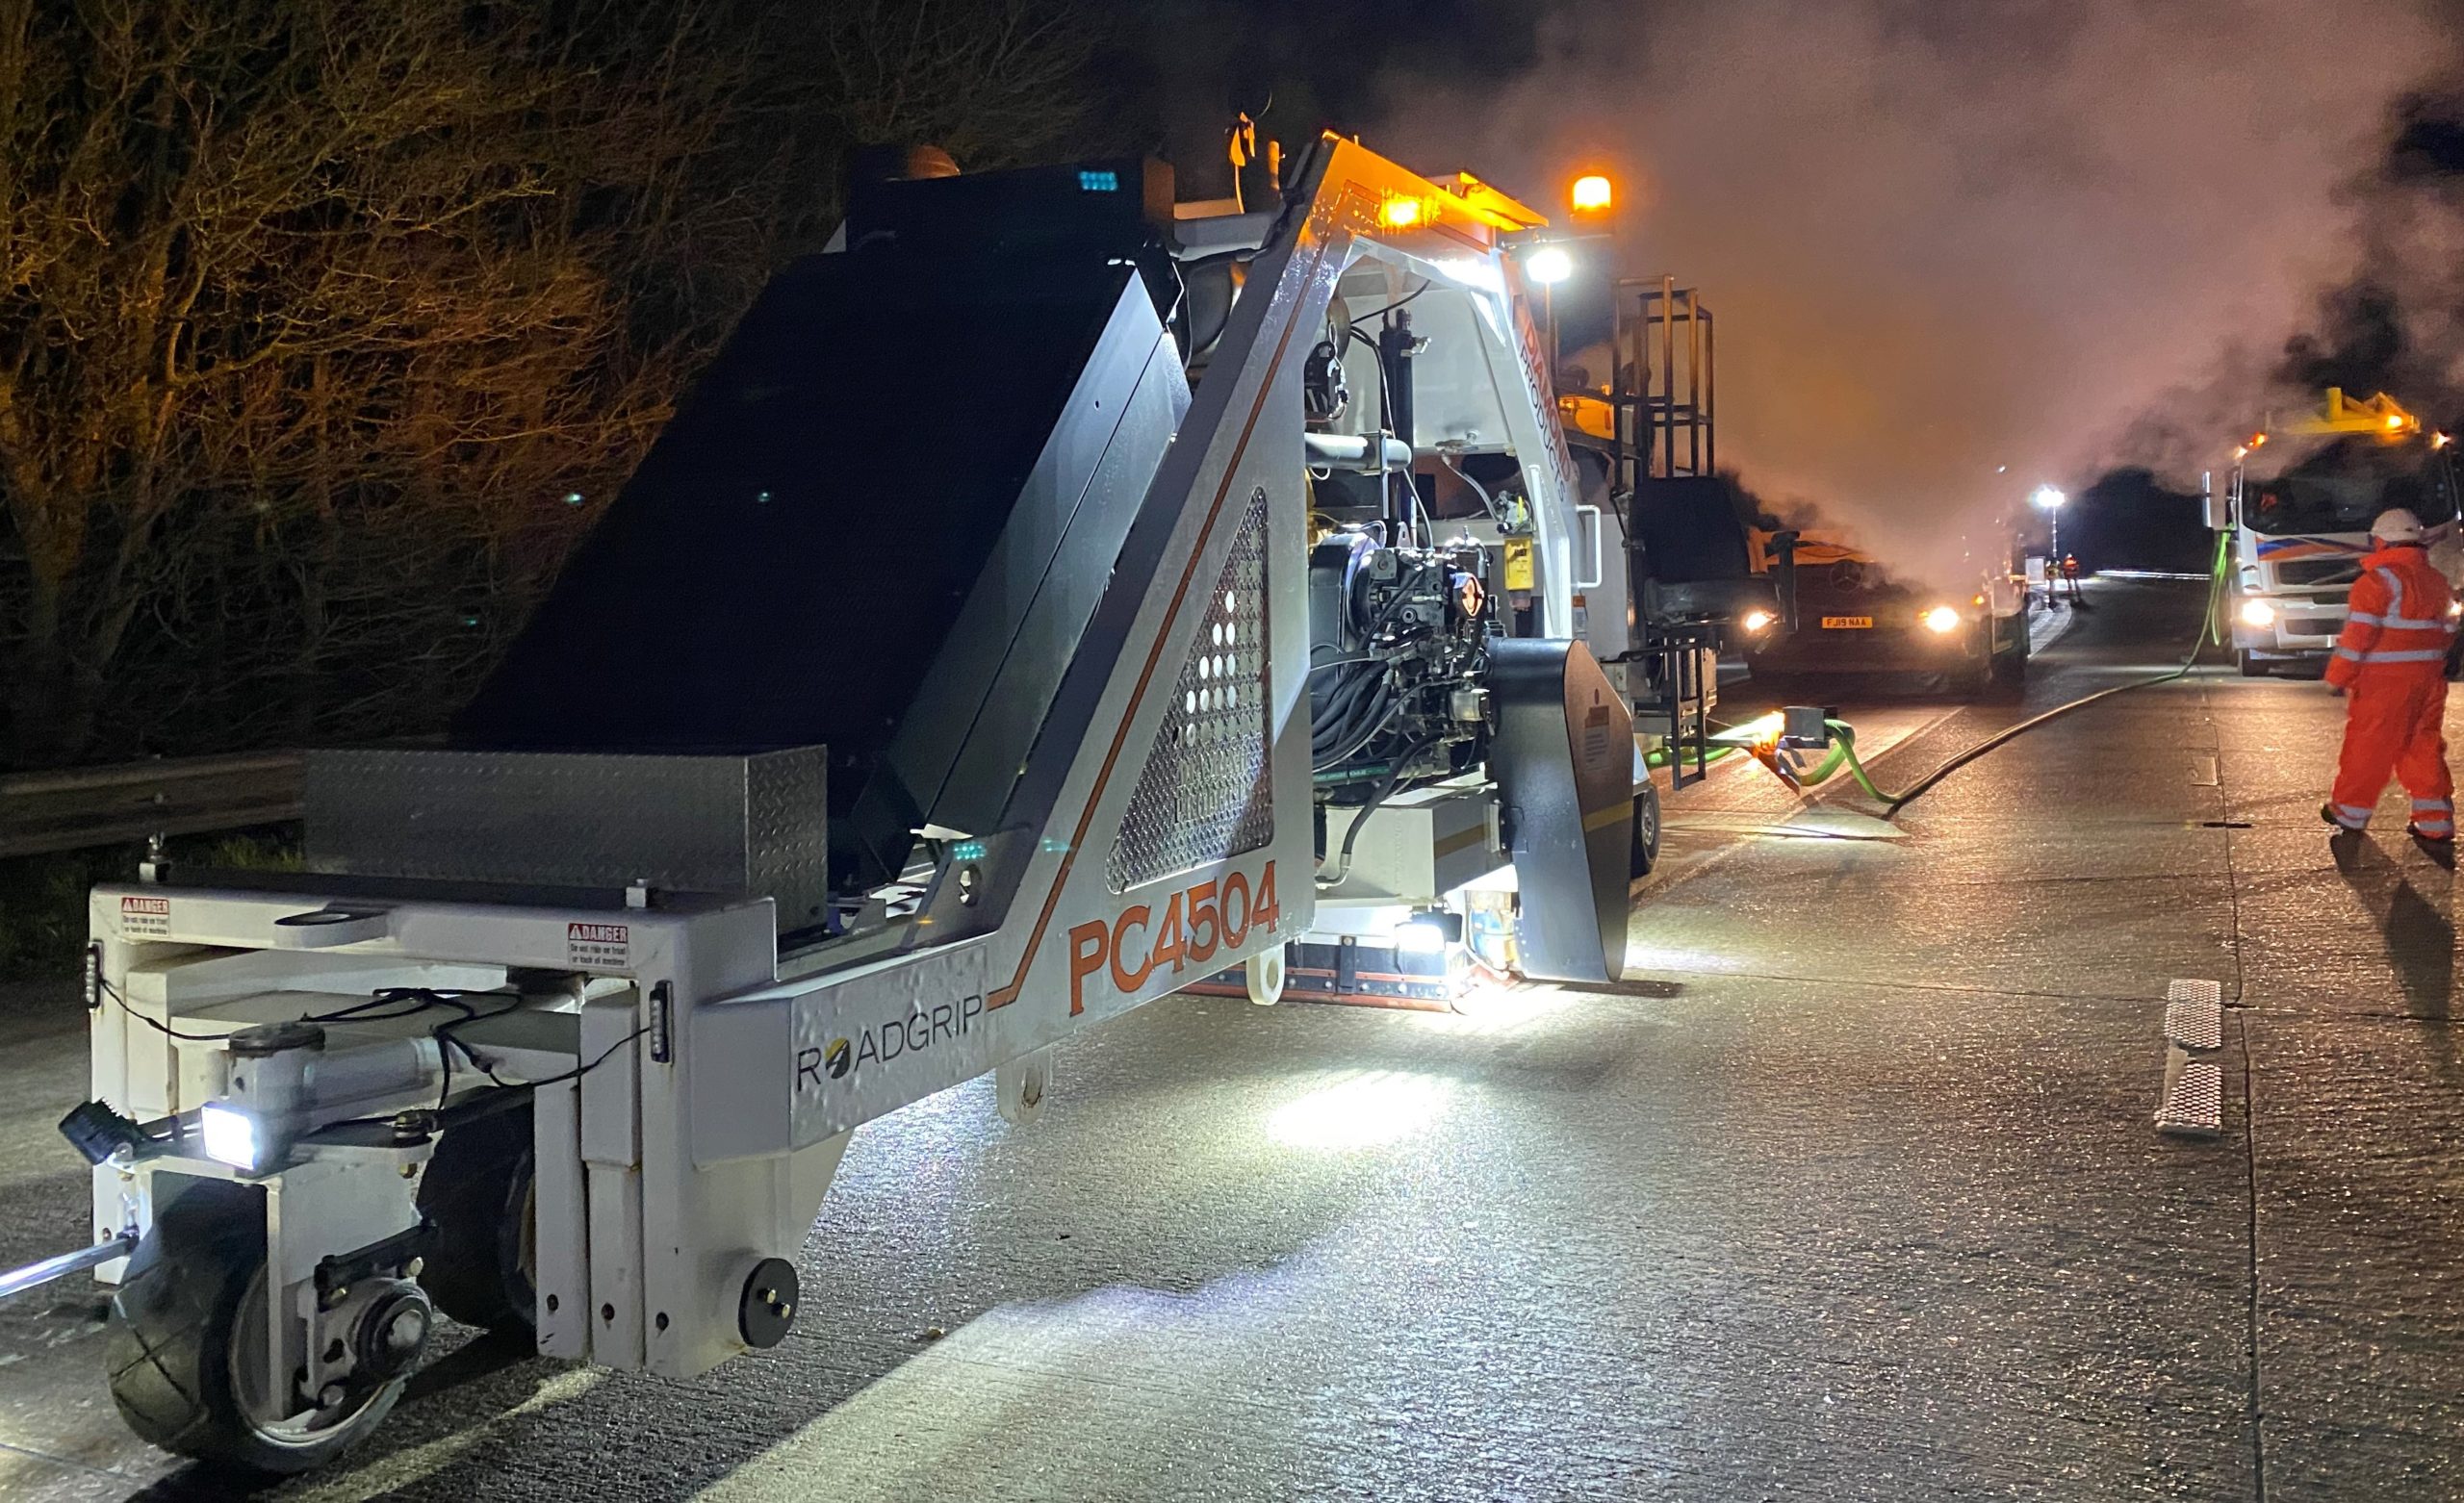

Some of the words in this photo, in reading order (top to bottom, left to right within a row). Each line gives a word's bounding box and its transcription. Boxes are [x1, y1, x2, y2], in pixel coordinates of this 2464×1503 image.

[1520, 344, 1567, 503] PRODUCTS
[1525, 322, 1572, 482] DIAMOND
[1826, 618, 1847, 626] FJ19
[581, 925, 627, 942] DANGER
[1068, 859, 1279, 1018] PC4504
[797, 995, 983, 1092] ROADGRIP
